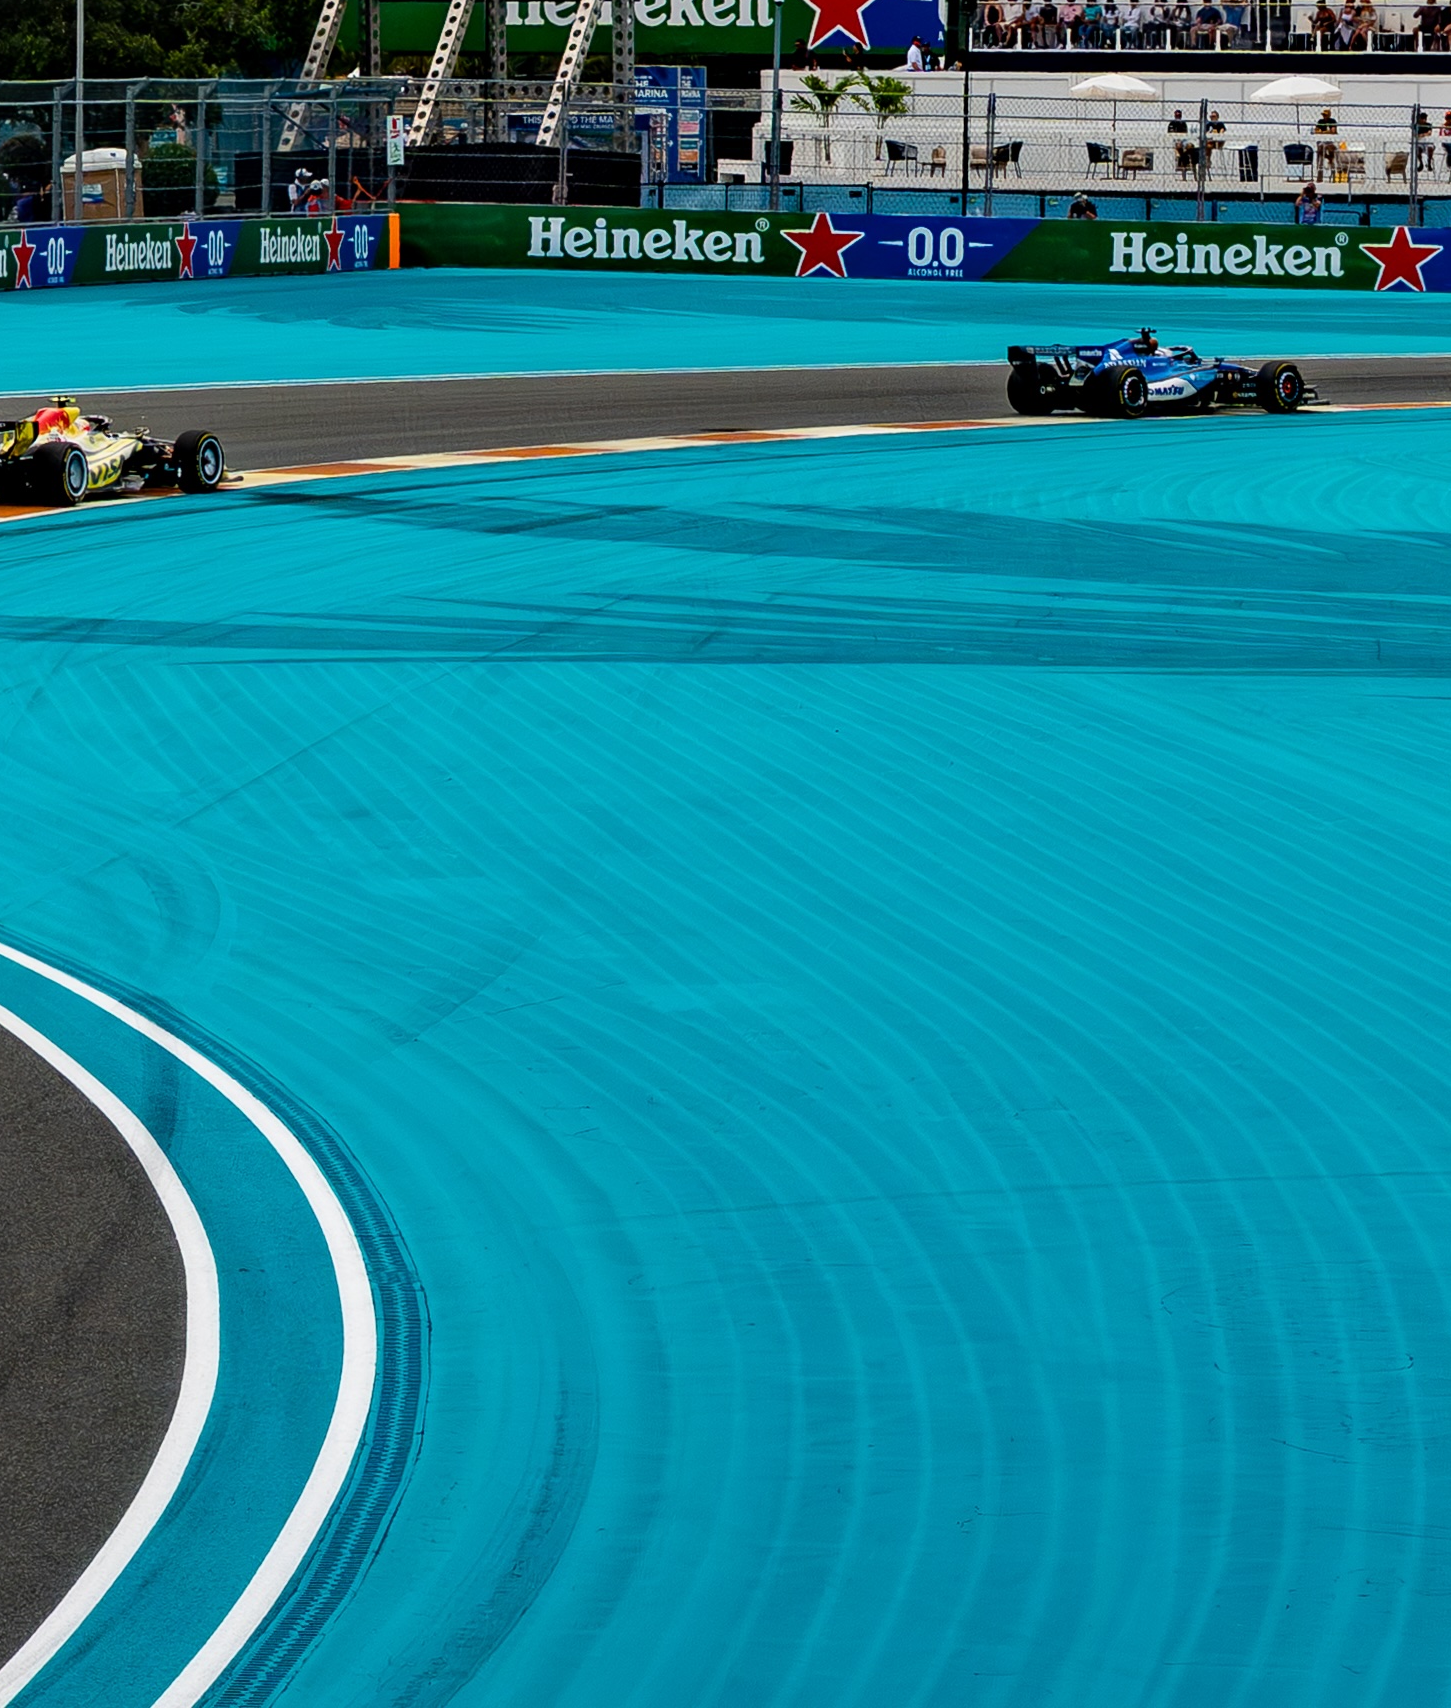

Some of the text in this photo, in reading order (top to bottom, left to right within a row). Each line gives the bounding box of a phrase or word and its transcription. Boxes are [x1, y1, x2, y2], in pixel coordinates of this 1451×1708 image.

[522, 116, 542, 124] THIS
[48, 238, 65, 274] 0.0
[208, 230, 224, 266] 0.0
[354, 224, 369, 259] 0.0
[908, 227, 964, 267] 0.0
[908, 267, 964, 278] ALCOHOL FREE
[1148, 384, 1185, 396] OMATSU
